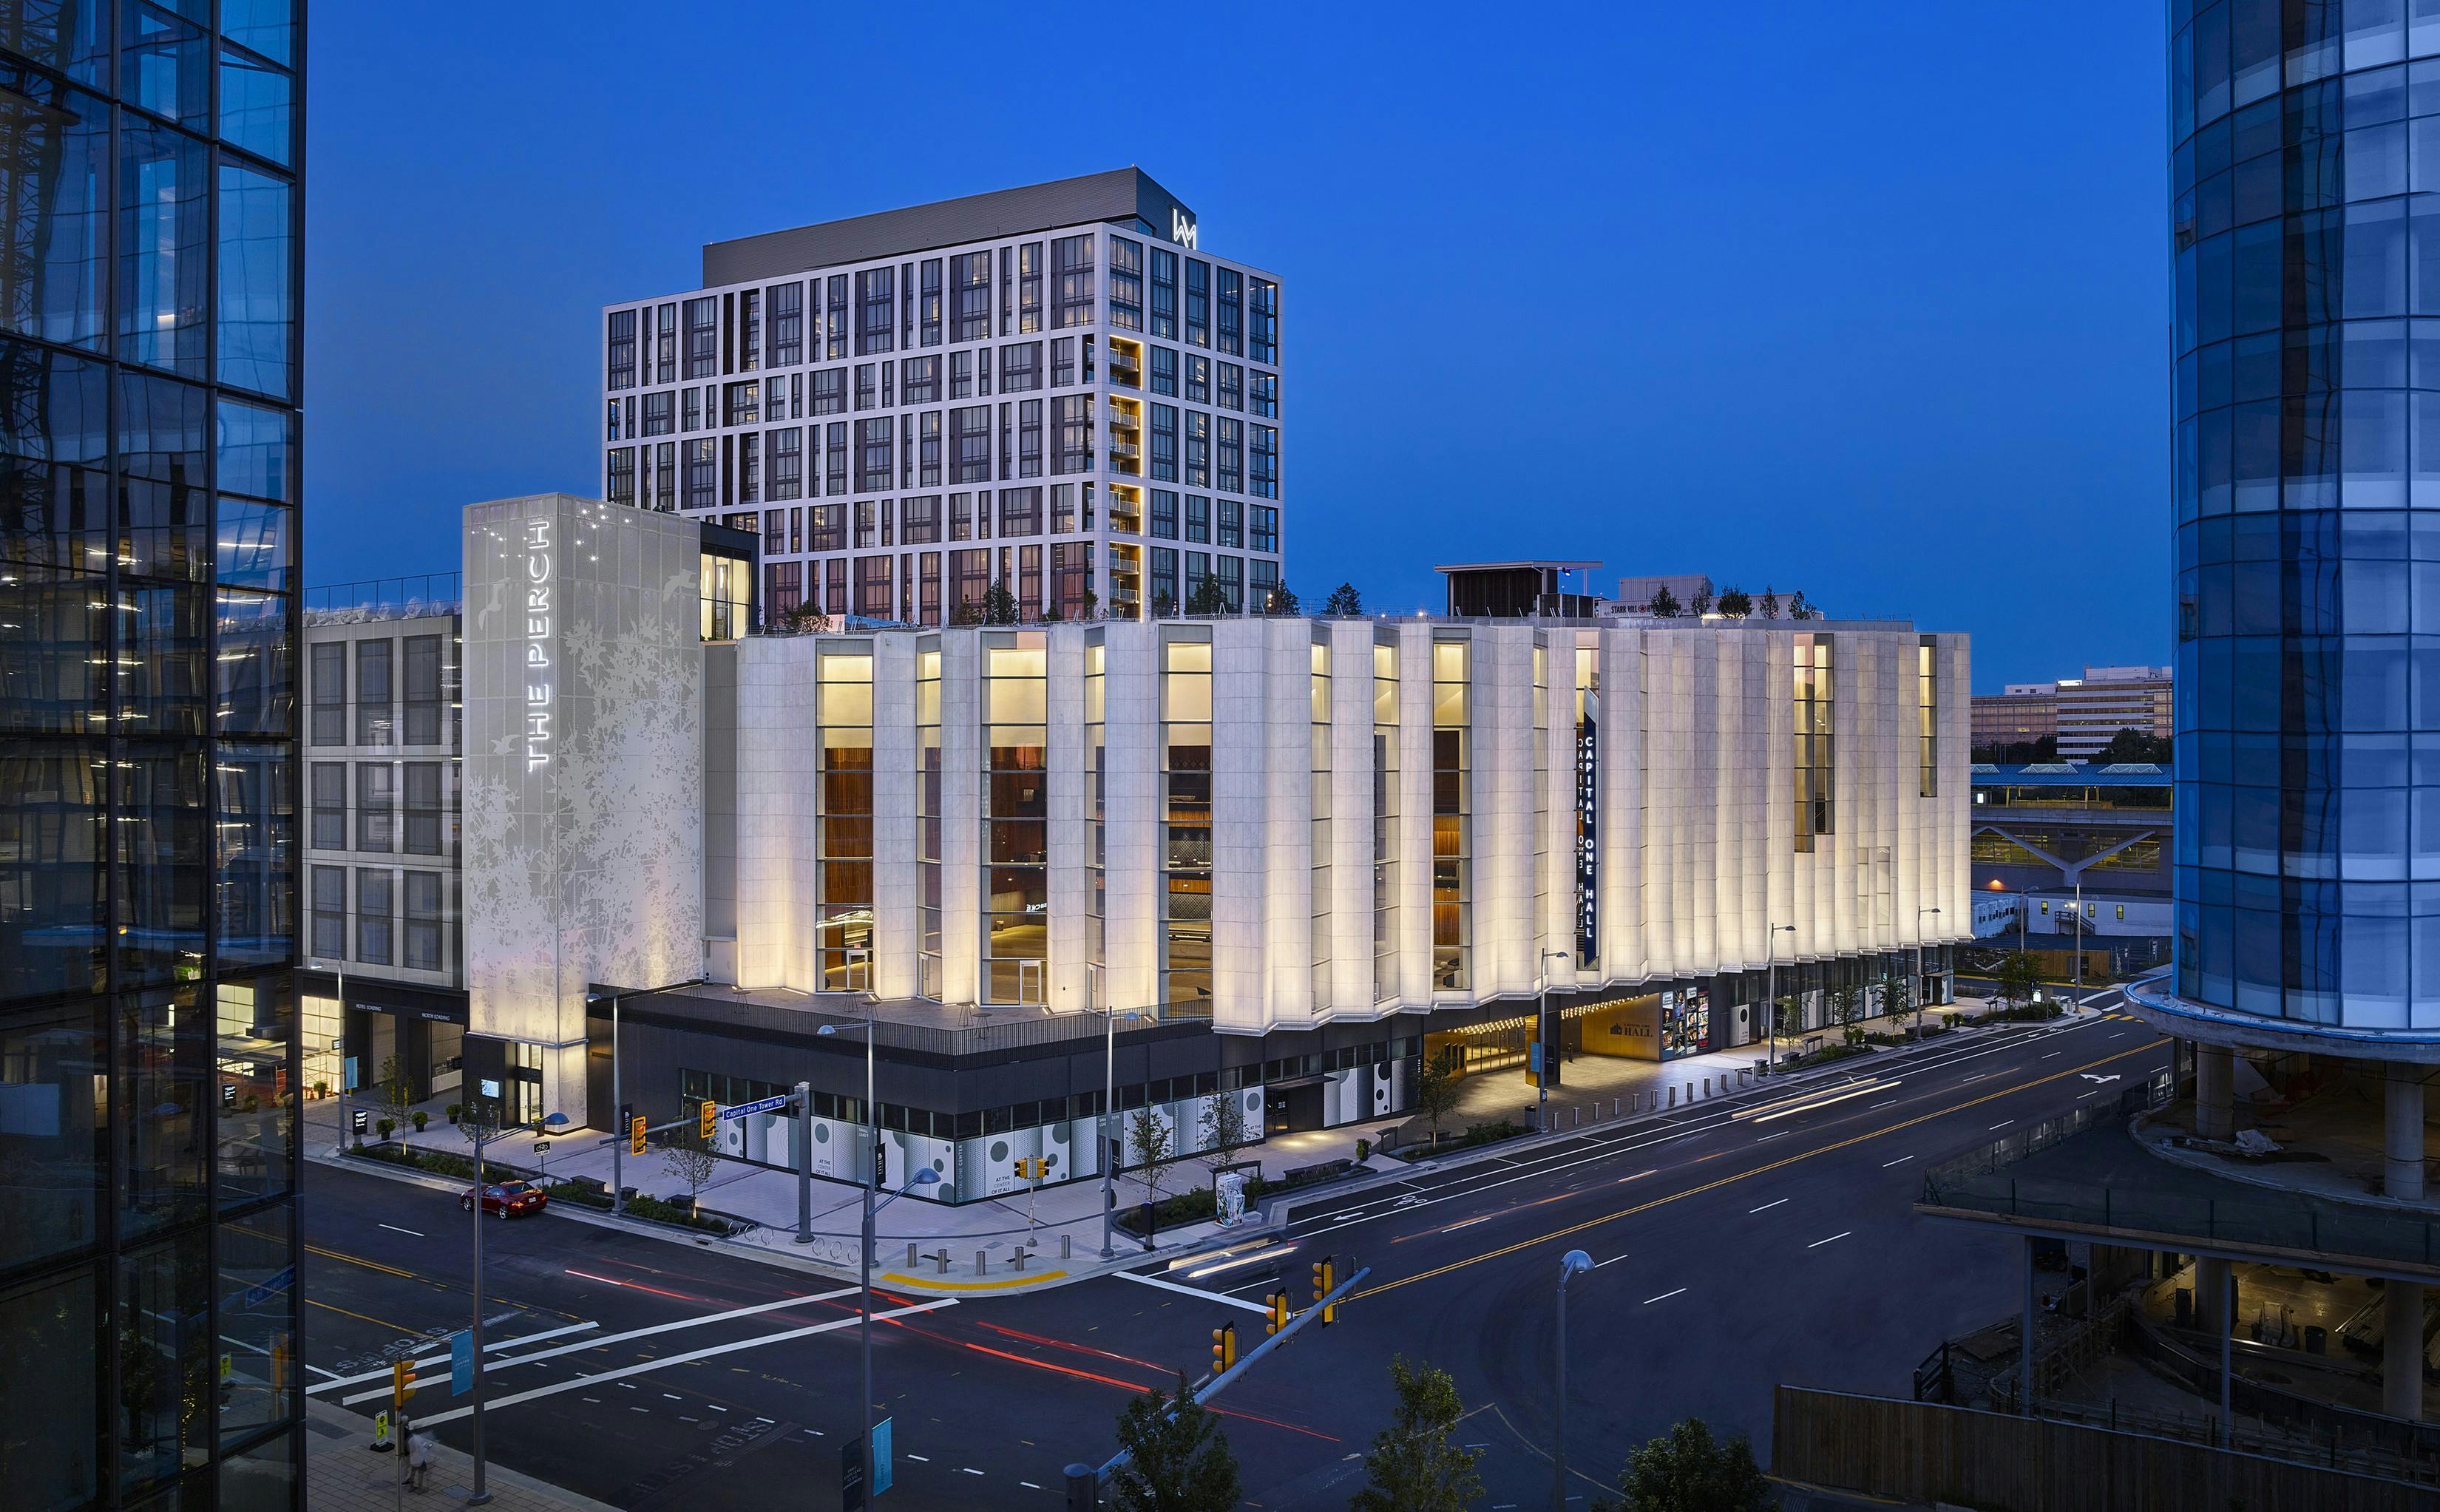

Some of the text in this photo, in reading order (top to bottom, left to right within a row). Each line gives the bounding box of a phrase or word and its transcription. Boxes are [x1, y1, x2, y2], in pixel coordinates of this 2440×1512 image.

[527, 519, 550, 774] THE PERCH
[1585, 736, 1593, 938] CAPITAL ONE HALL
[1625, 1028, 1653, 1037] HALL
[726, 1108, 745, 1117] Capital
